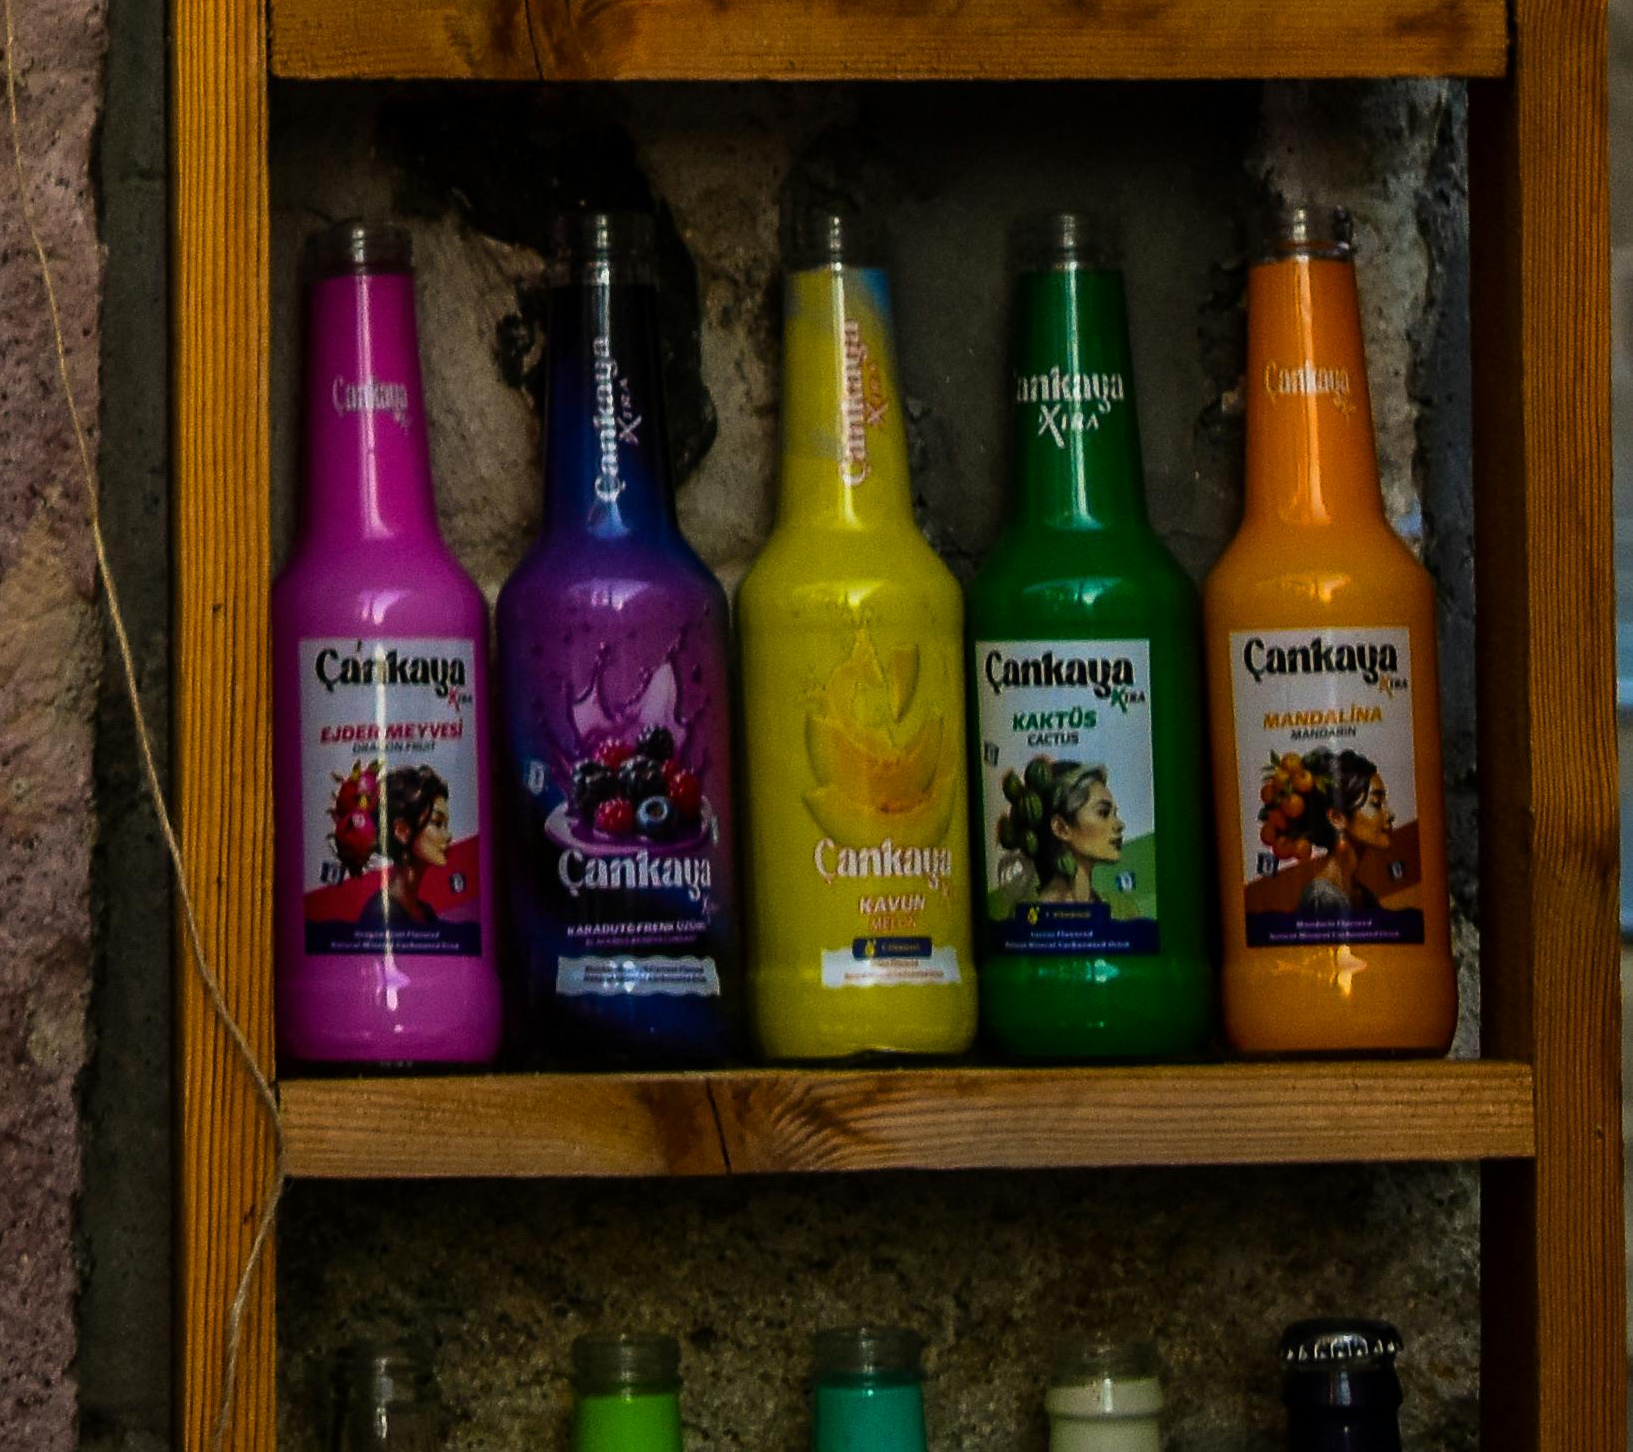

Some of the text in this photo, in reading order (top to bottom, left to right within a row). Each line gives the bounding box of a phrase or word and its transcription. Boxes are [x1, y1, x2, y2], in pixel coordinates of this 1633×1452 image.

[593, 337, 626, 503] Çankaya
[315, 648, 466, 698] Çankaya
[985, 649, 1135, 699] Çankaya
[1243, 636, 1398, 685] Çankaya
[320, 717, 463, 744] EJDER MEYVESİ
[1012, 706, 1098, 732] KAKTÜS
[1027, 731, 1080, 746] CACTUS
[1263, 701, 1383, 730] MANDALİNA
[558, 848, 712, 902] Çankaya
[815, 837, 952, 890] Çankaya
[859, 894, 926, 914] KAVUN
